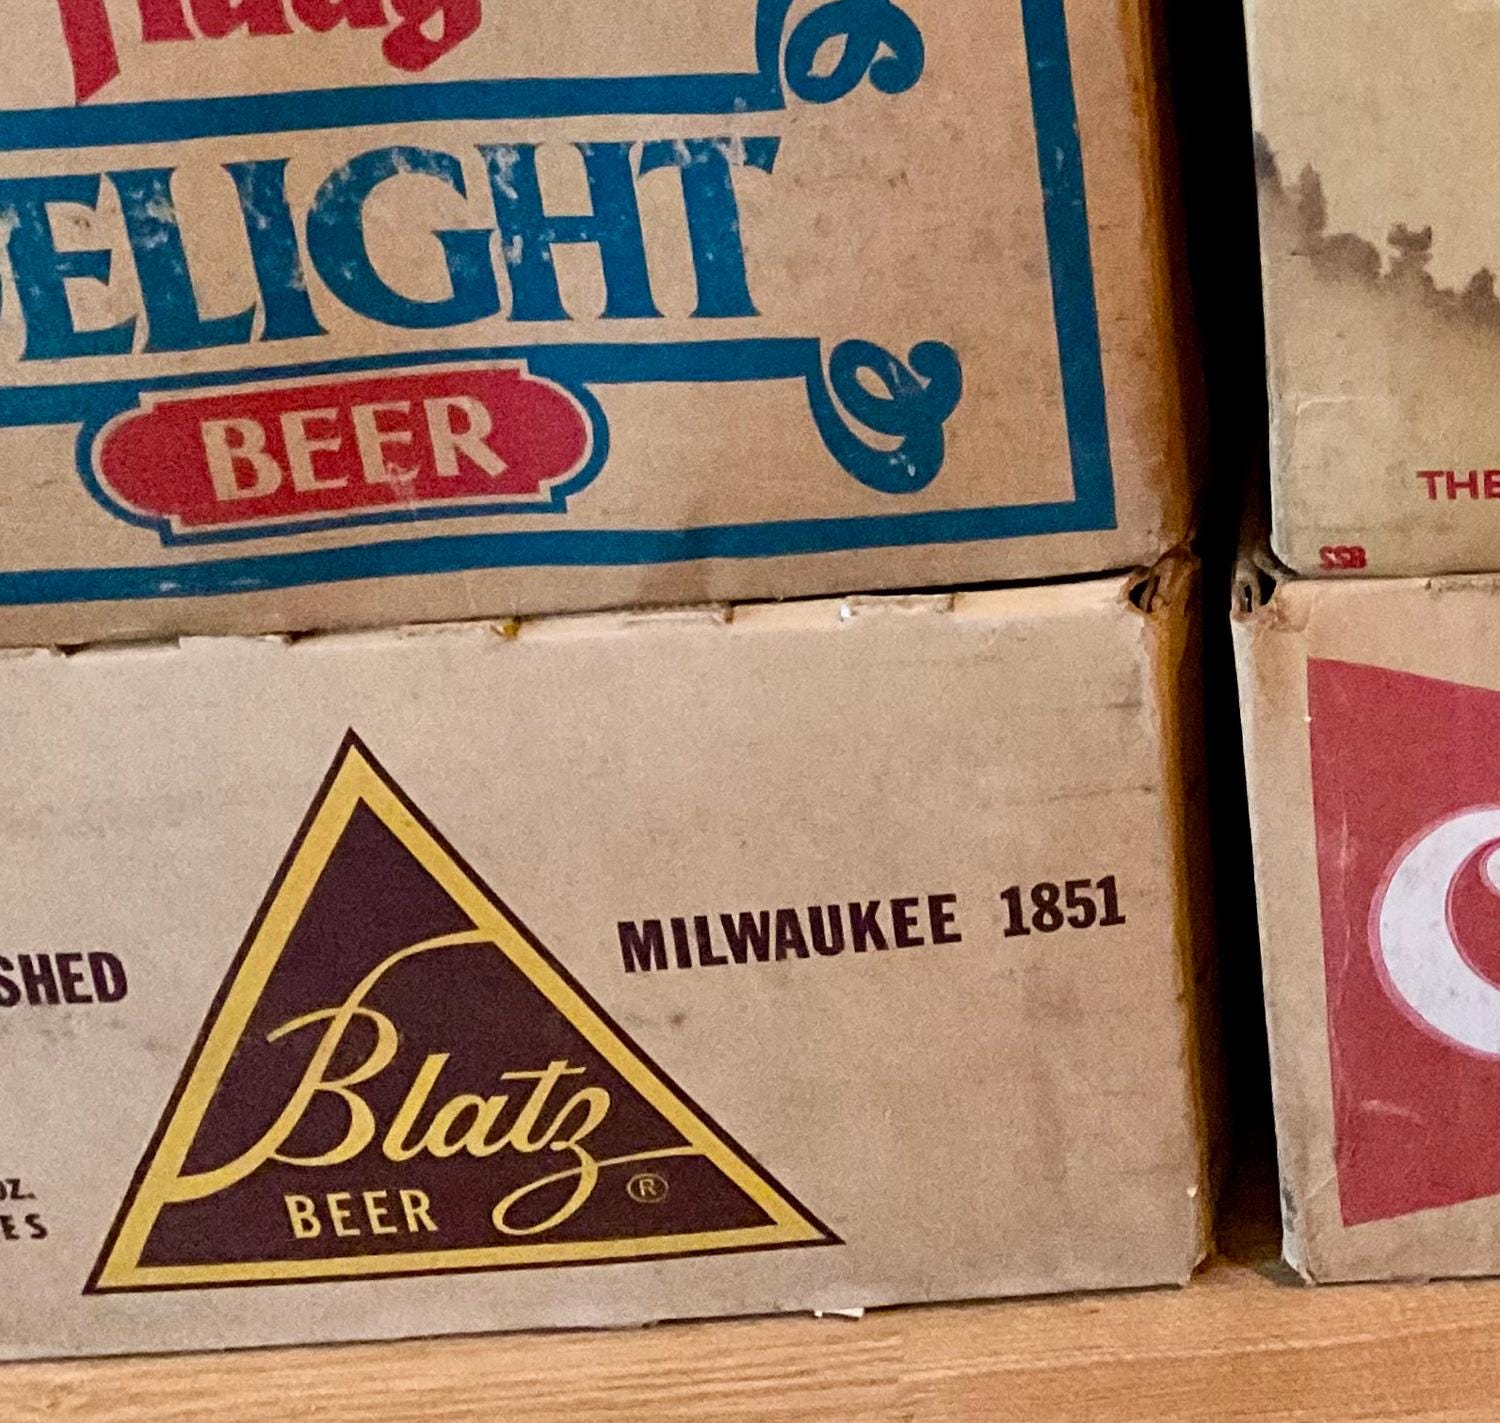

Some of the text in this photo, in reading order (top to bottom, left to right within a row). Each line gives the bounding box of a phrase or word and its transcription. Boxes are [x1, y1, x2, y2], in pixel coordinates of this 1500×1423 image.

[0, 134, 781, 362] ELIGHT
[201, 394, 508, 502] BEER
[617, 874, 1126, 974] MILWAUKEE 1851
[190, 946, 630, 1236] Blatz
[286, 1188, 439, 1242] BEER
